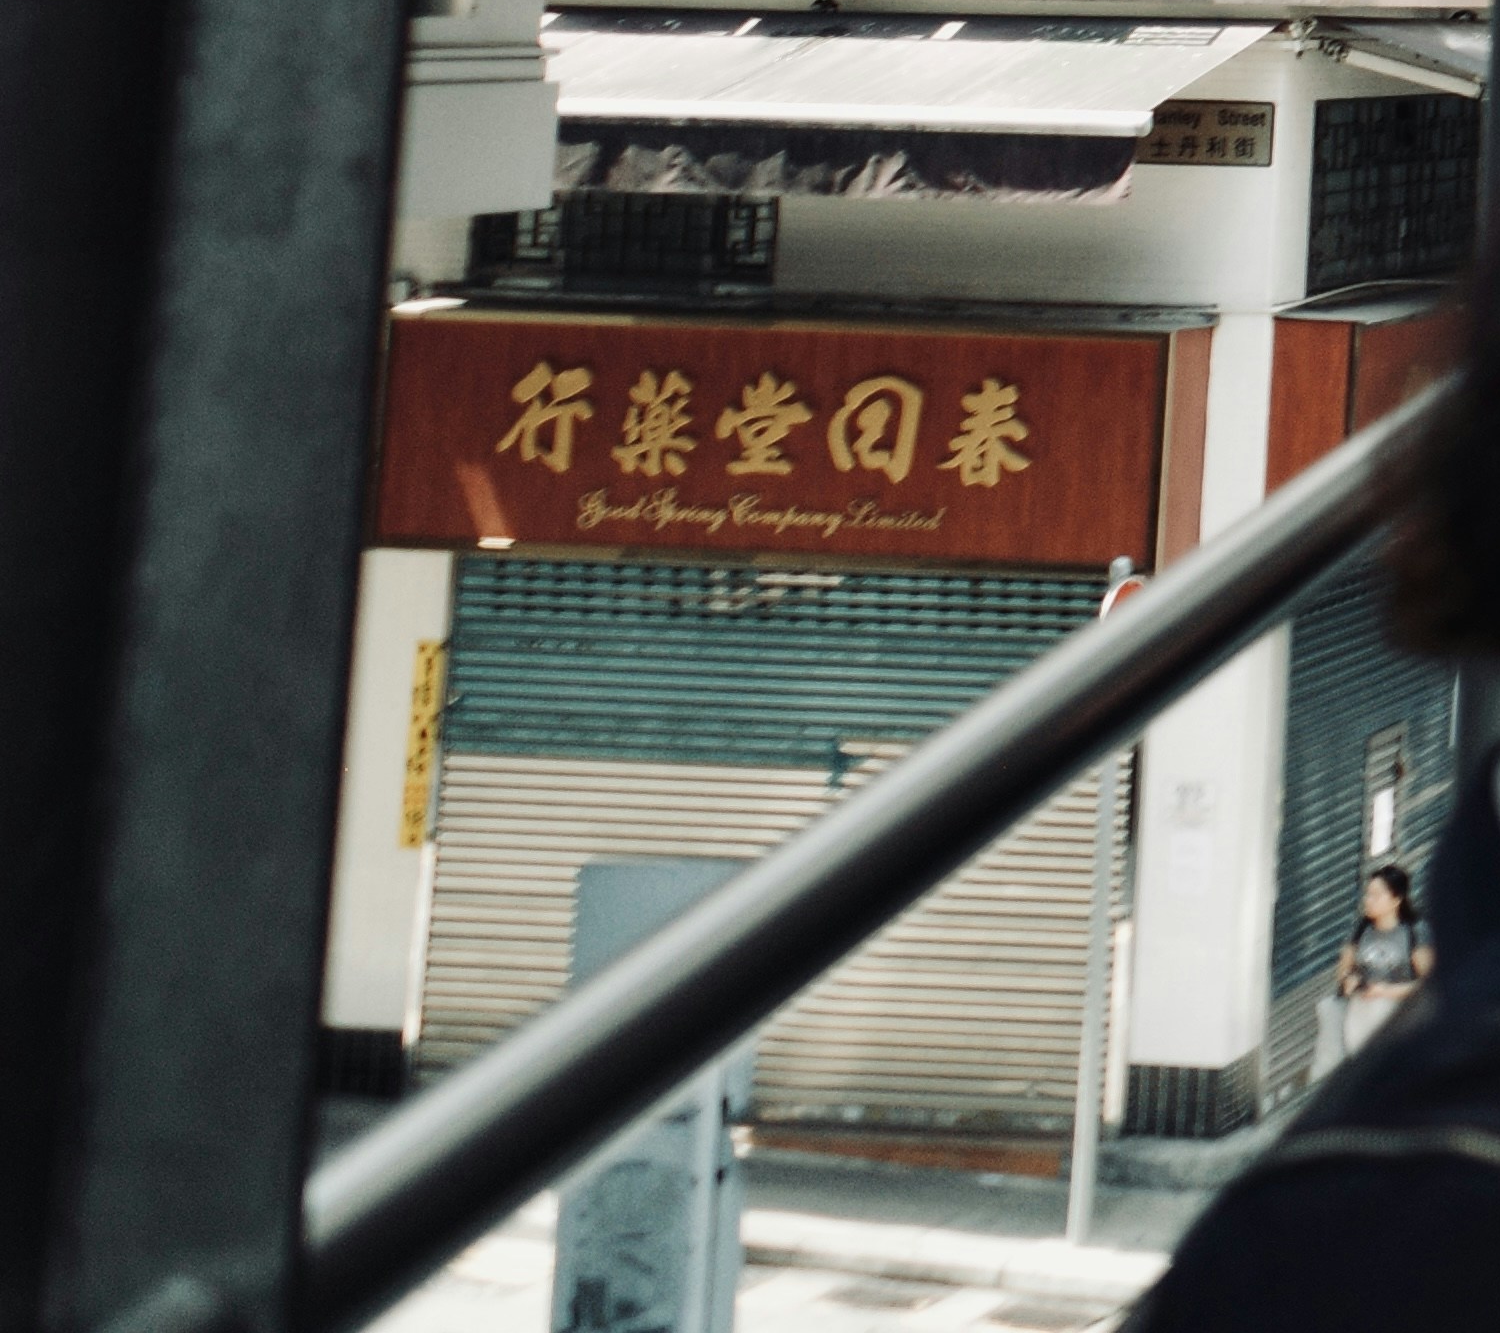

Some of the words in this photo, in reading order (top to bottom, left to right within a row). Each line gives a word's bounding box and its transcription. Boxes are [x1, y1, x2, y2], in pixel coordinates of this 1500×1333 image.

[1217, 108, 1267, 127] Street
[1150, 136, 1257, 158] 士丹利街
[641, 487, 729, 533] Spring
[728, 493, 843, 537] Company
[843, 496, 948, 533] Limited
